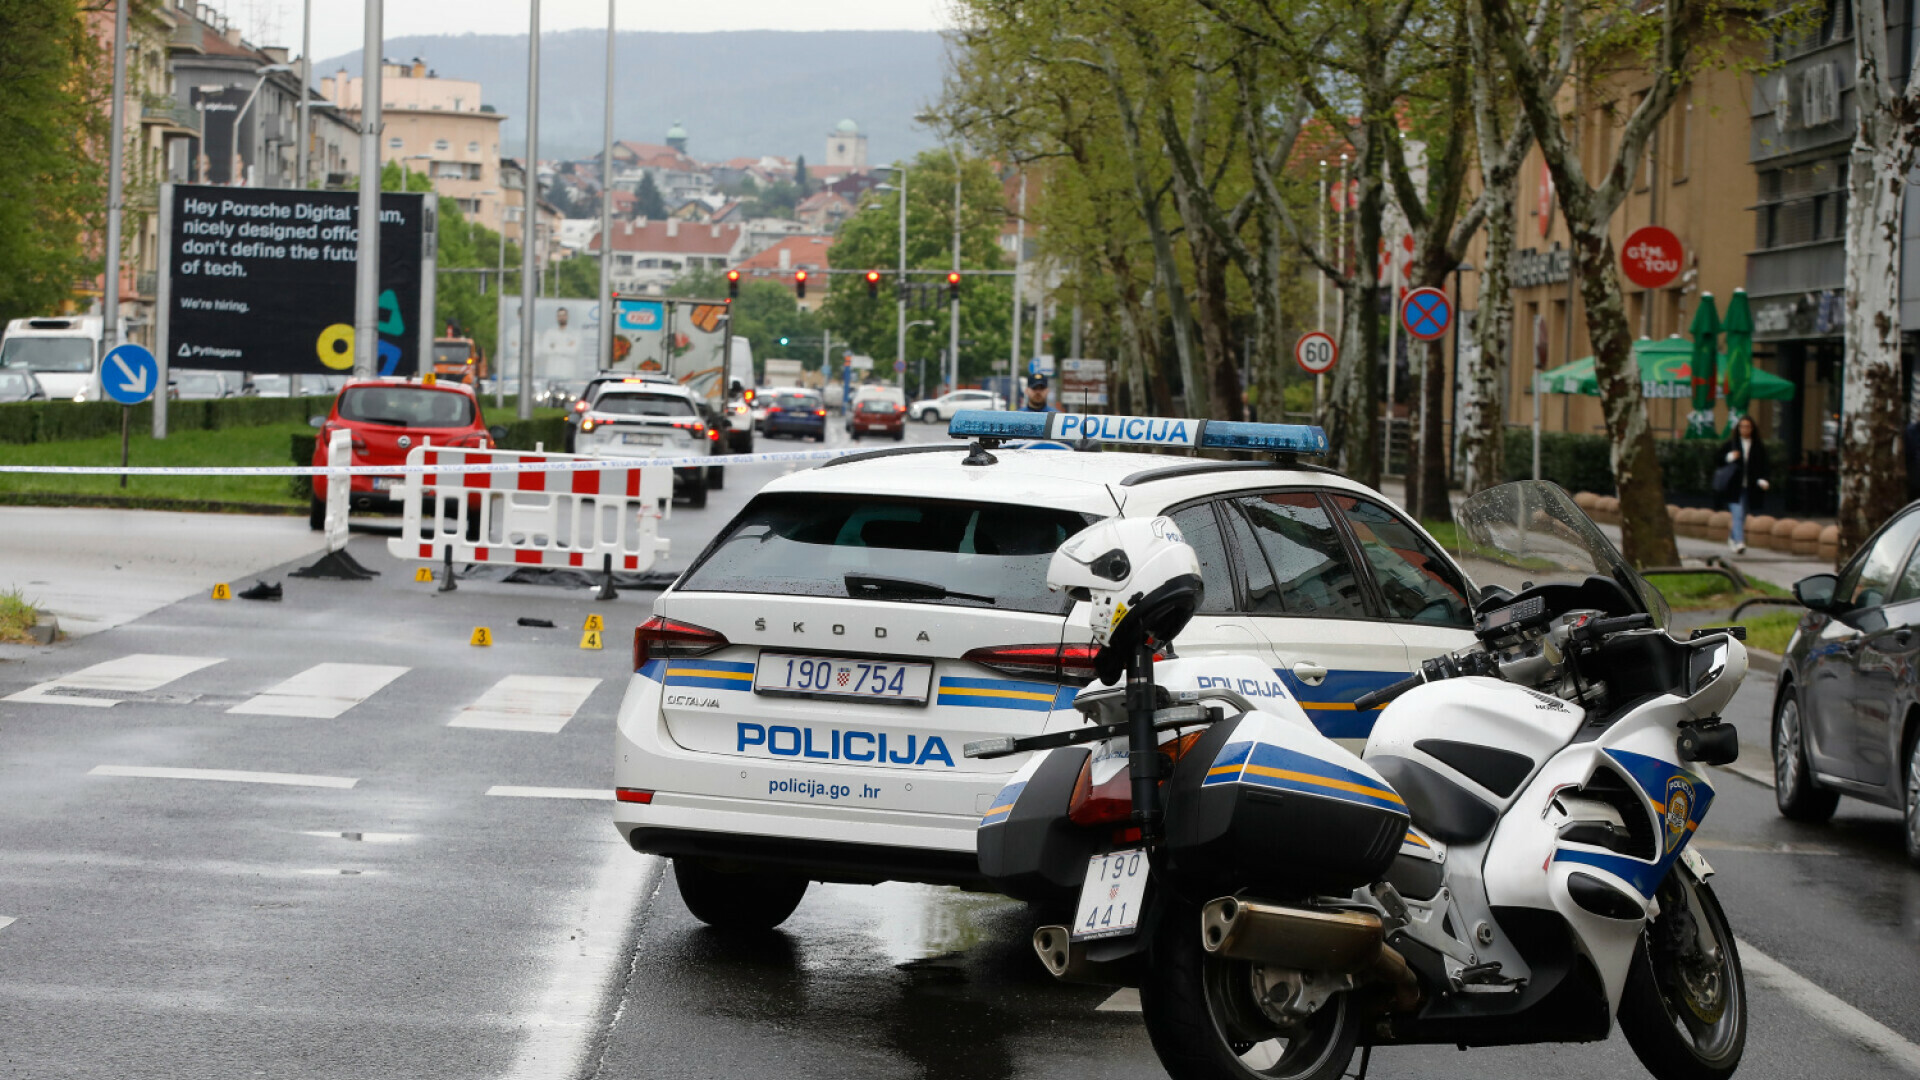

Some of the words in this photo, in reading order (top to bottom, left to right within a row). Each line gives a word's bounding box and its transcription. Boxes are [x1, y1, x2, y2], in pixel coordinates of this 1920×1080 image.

[183, 198, 217, 217] Hey
[221, 201, 291, 219] Porsche
[294, 203, 351, 223] Digital
[183, 220, 235, 239] nicely
[238, 223, 318, 242] designed
[321, 226, 361, 242] offic
[182, 239, 228, 256] don't
[231, 241, 286, 259] define
[290, 243, 319, 260] the
[323, 244, 358, 262] futu
[181, 260, 201, 275] of
[204, 260, 248, 278] tech.
[180, 297, 212, 310] We're
[214, 299, 250, 313] hiring.
[192, 346, 243, 358] Pythagora
[1306, 342, 1330, 362] 60
[1060, 414, 1188, 444] POLICIJA
[421, 569, 427, 580] 7
[217, 584, 225, 597] 6
[589, 616, 597, 629] 5
[754, 616, 931, 643] ŠKODA
[478, 629, 486, 643] 3
[588, 633, 597, 646] 4
[786, 659, 832, 690] 190
[854, 663, 906, 695] 754
[1196, 675, 1287, 700] POLICIJA
[667, 695, 720, 708] OCTAVIA
[737, 721, 955, 768] POLICIJA
[769, 778, 850, 800] policija.go
[1101, 853, 1140, 882] 190
[1085, 902, 1127, 929] 441
